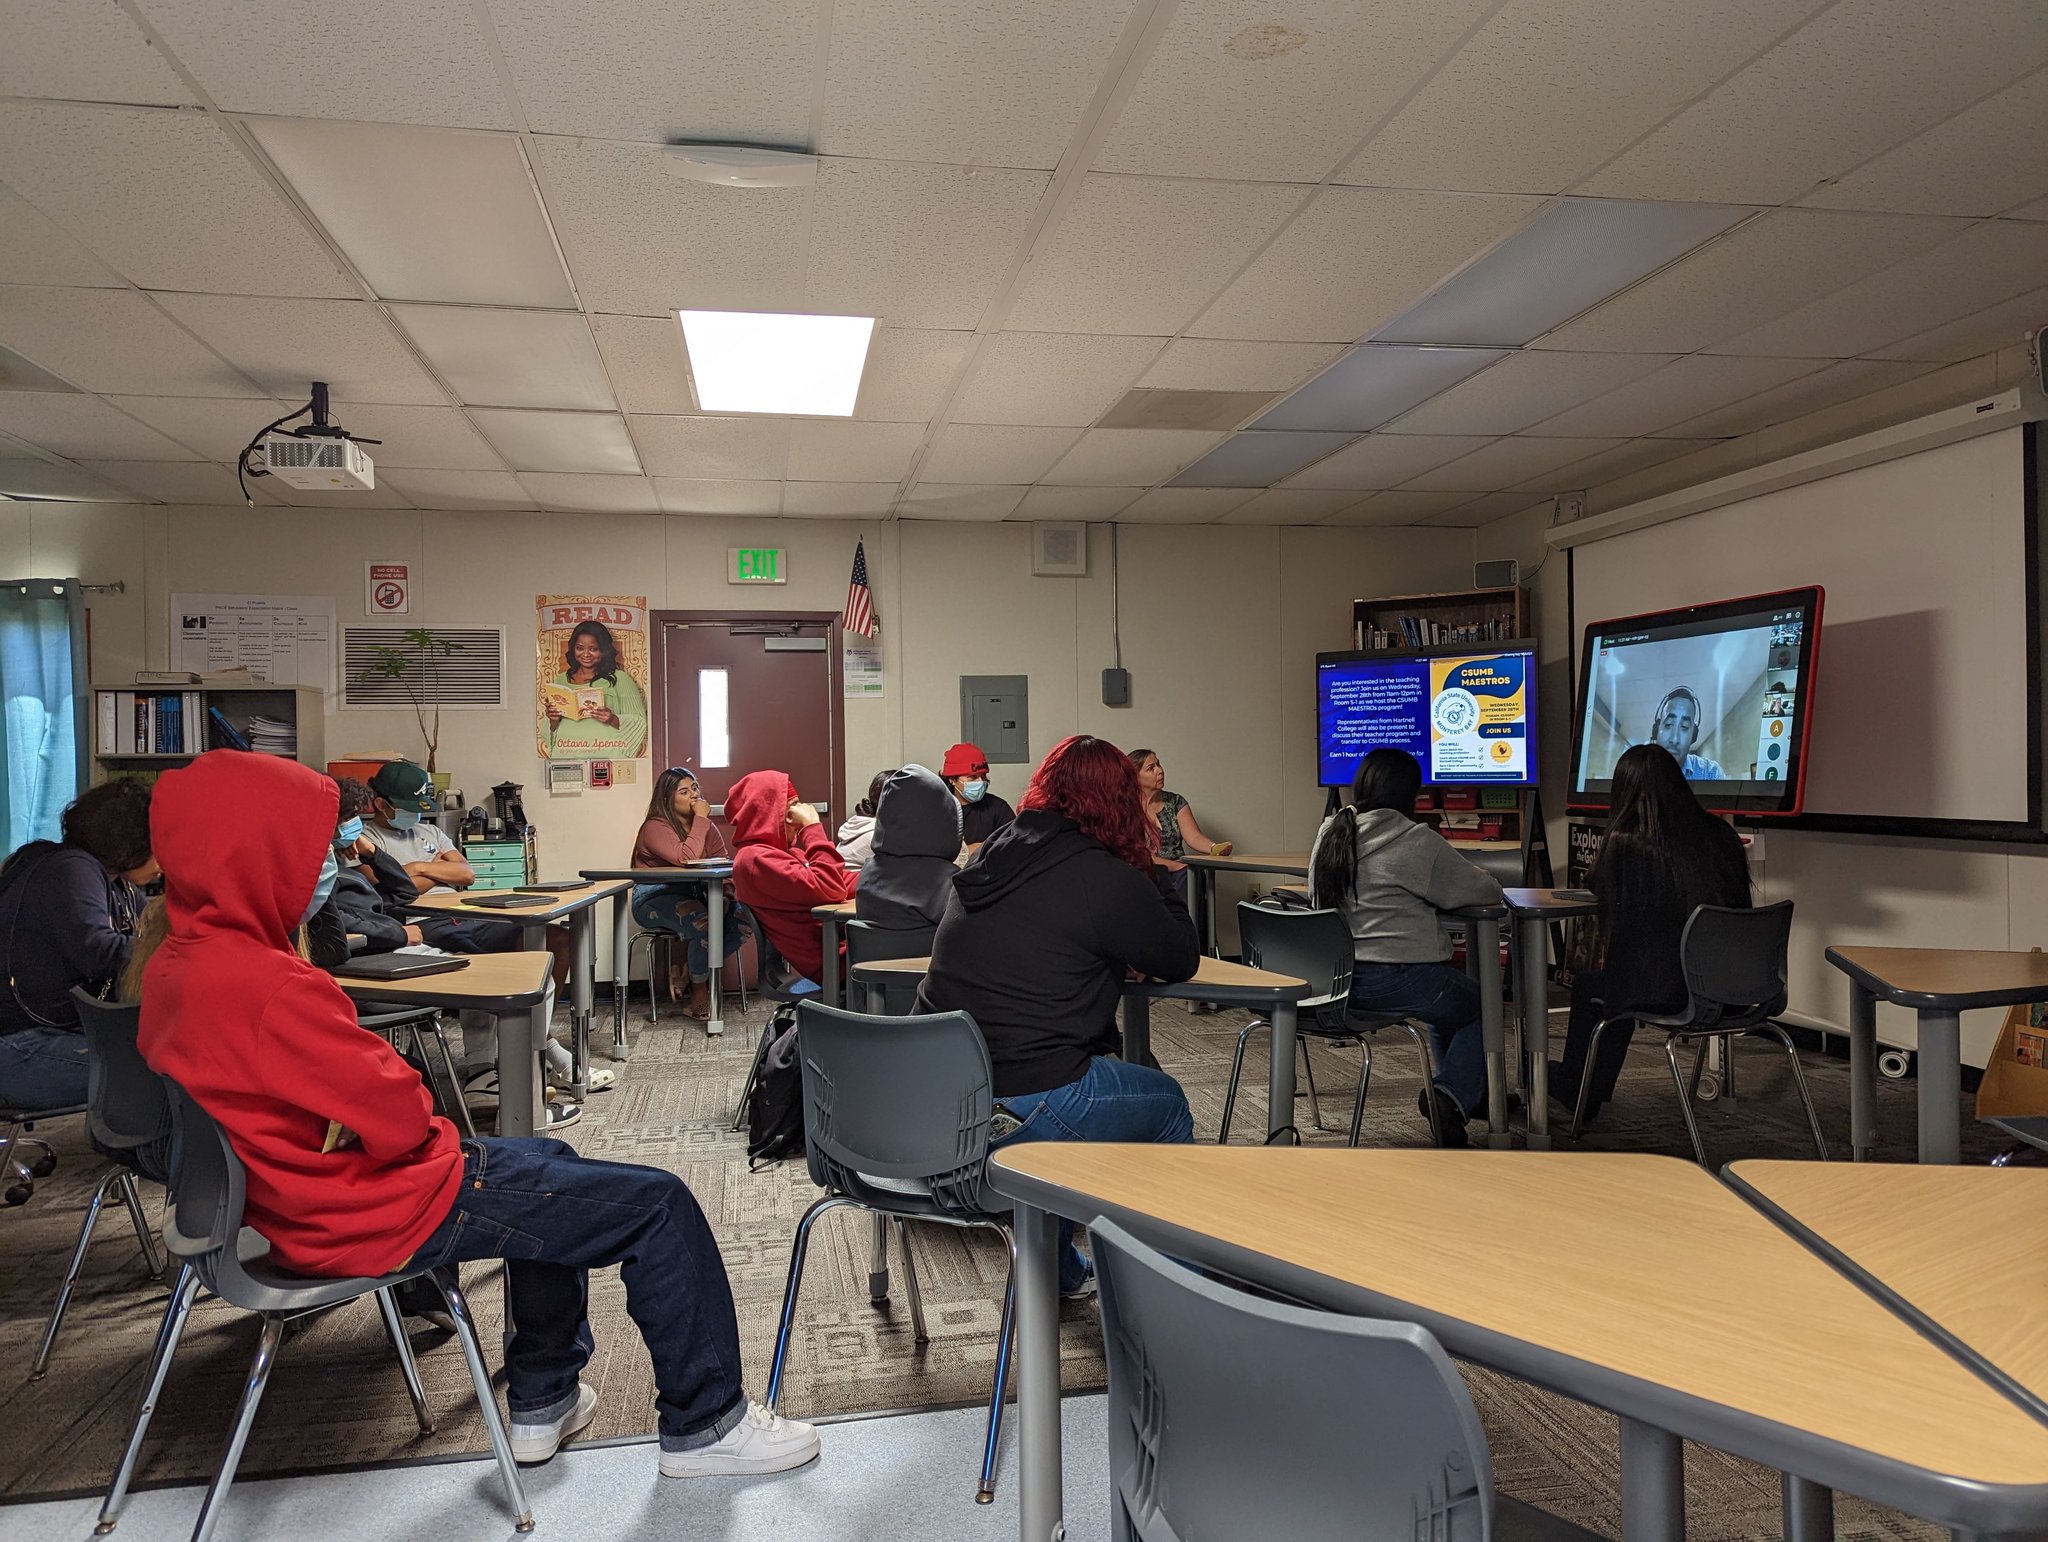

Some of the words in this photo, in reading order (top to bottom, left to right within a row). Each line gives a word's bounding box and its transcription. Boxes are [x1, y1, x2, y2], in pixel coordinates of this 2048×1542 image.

[739, 549, 778, 579] EXIT
[552, 607, 633, 625] READ
[1461, 668, 1493, 677] CSUMB
[1461, 677, 1510, 686] MAESTROS
[1434, 696, 1447, 718] California
[1461, 694, 1475, 717] University
[1437, 721, 1464, 734] MONTEREY
[1464, 720, 1473, 730] BAY
[557, 739, 589, 748] Octavia
[592, 739, 628, 751] Spencer
